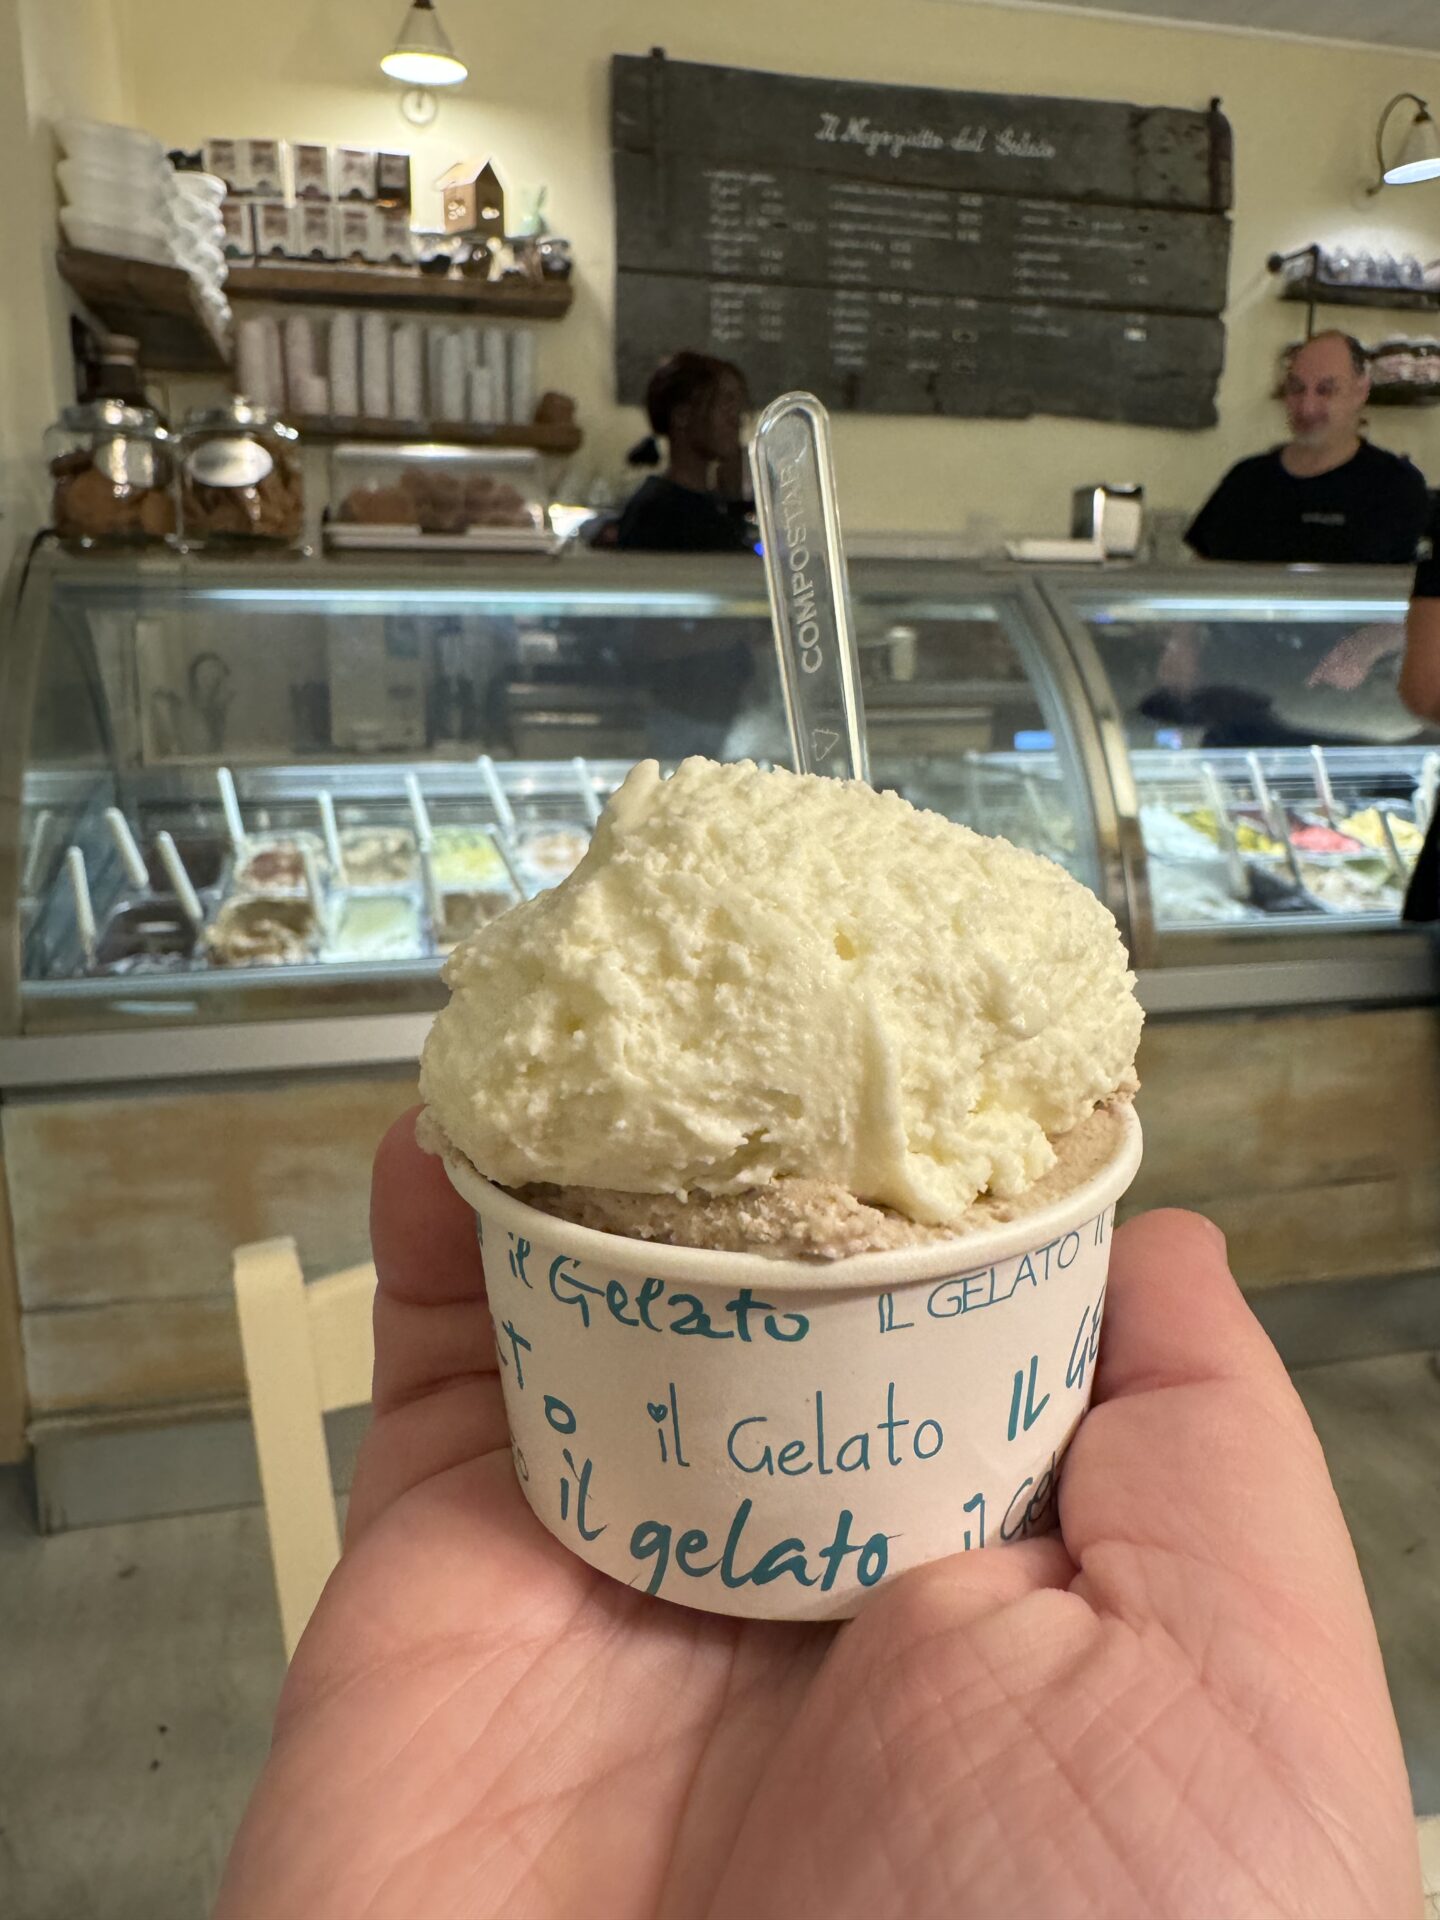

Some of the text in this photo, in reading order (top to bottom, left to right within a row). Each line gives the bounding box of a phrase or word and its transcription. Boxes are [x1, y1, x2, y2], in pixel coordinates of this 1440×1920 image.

[507, 1231, 810, 1343] il Gelato
[877, 1292, 915, 1334] IL
[926, 1230, 1080, 1319] GELATO
[646, 1381, 945, 1477] il Gelato
[1006, 1354, 1051, 1442] IL
[560, 1448, 608, 1542] il
[629, 1498, 904, 1597] gelato
